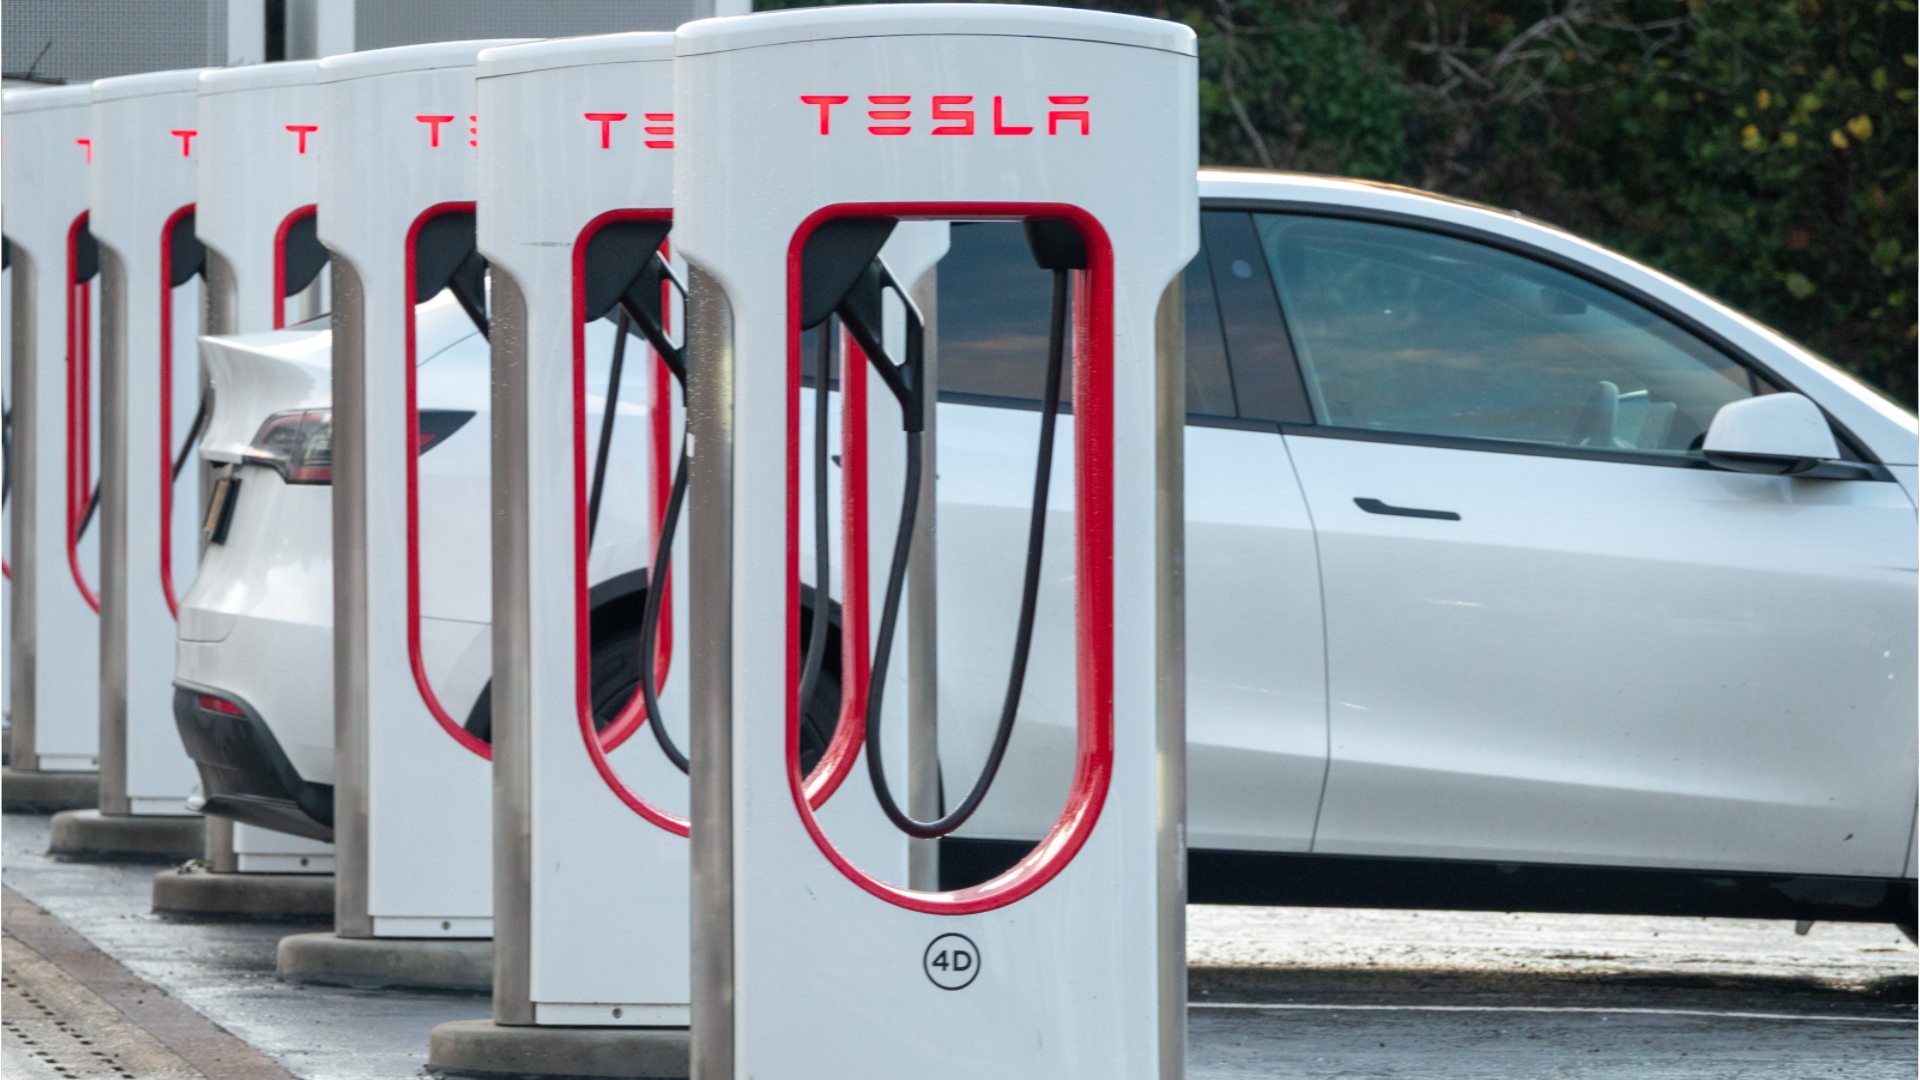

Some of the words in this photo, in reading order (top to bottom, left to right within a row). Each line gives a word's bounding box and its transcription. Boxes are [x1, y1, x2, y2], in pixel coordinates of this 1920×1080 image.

[414, 115, 478, 148] T
[583, 112, 675, 149] TE
[799, 95, 1091, 136] TESLA
[931, 949, 972, 972] 4D
